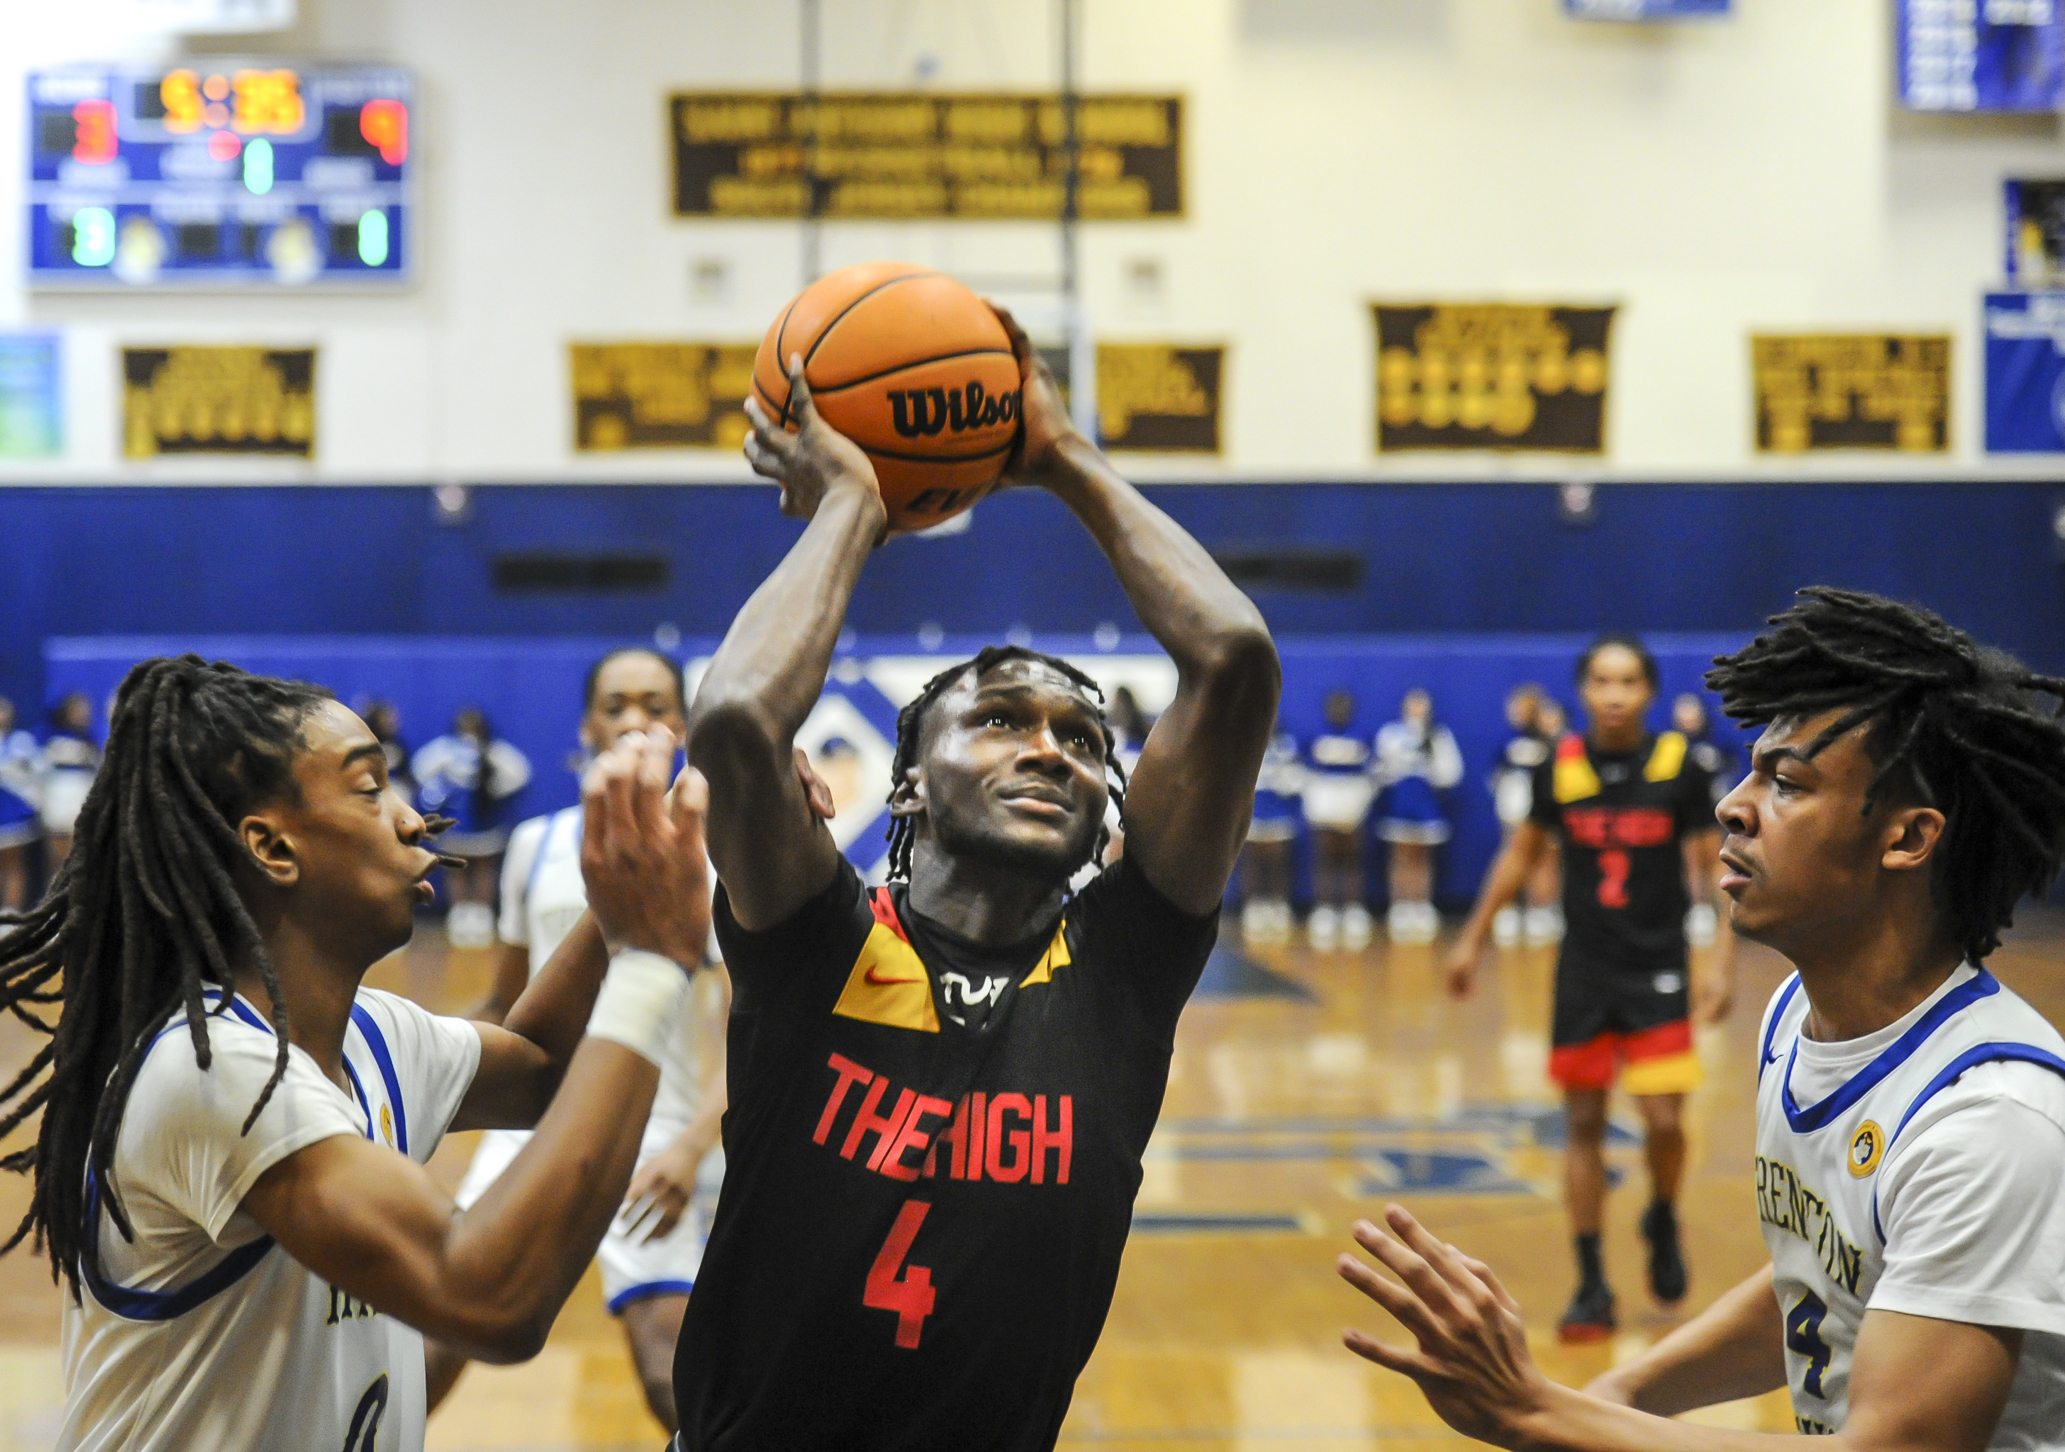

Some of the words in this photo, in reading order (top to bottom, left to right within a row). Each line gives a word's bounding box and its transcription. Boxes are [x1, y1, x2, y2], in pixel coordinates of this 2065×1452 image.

[1598, 851, 1630, 908] 2
[812, 1052, 952, 1182] THE
[921, 1092, 1073, 1185] HIGH
[863, 1200, 936, 1349] 4
[1785, 1288, 1832, 1400] 4
